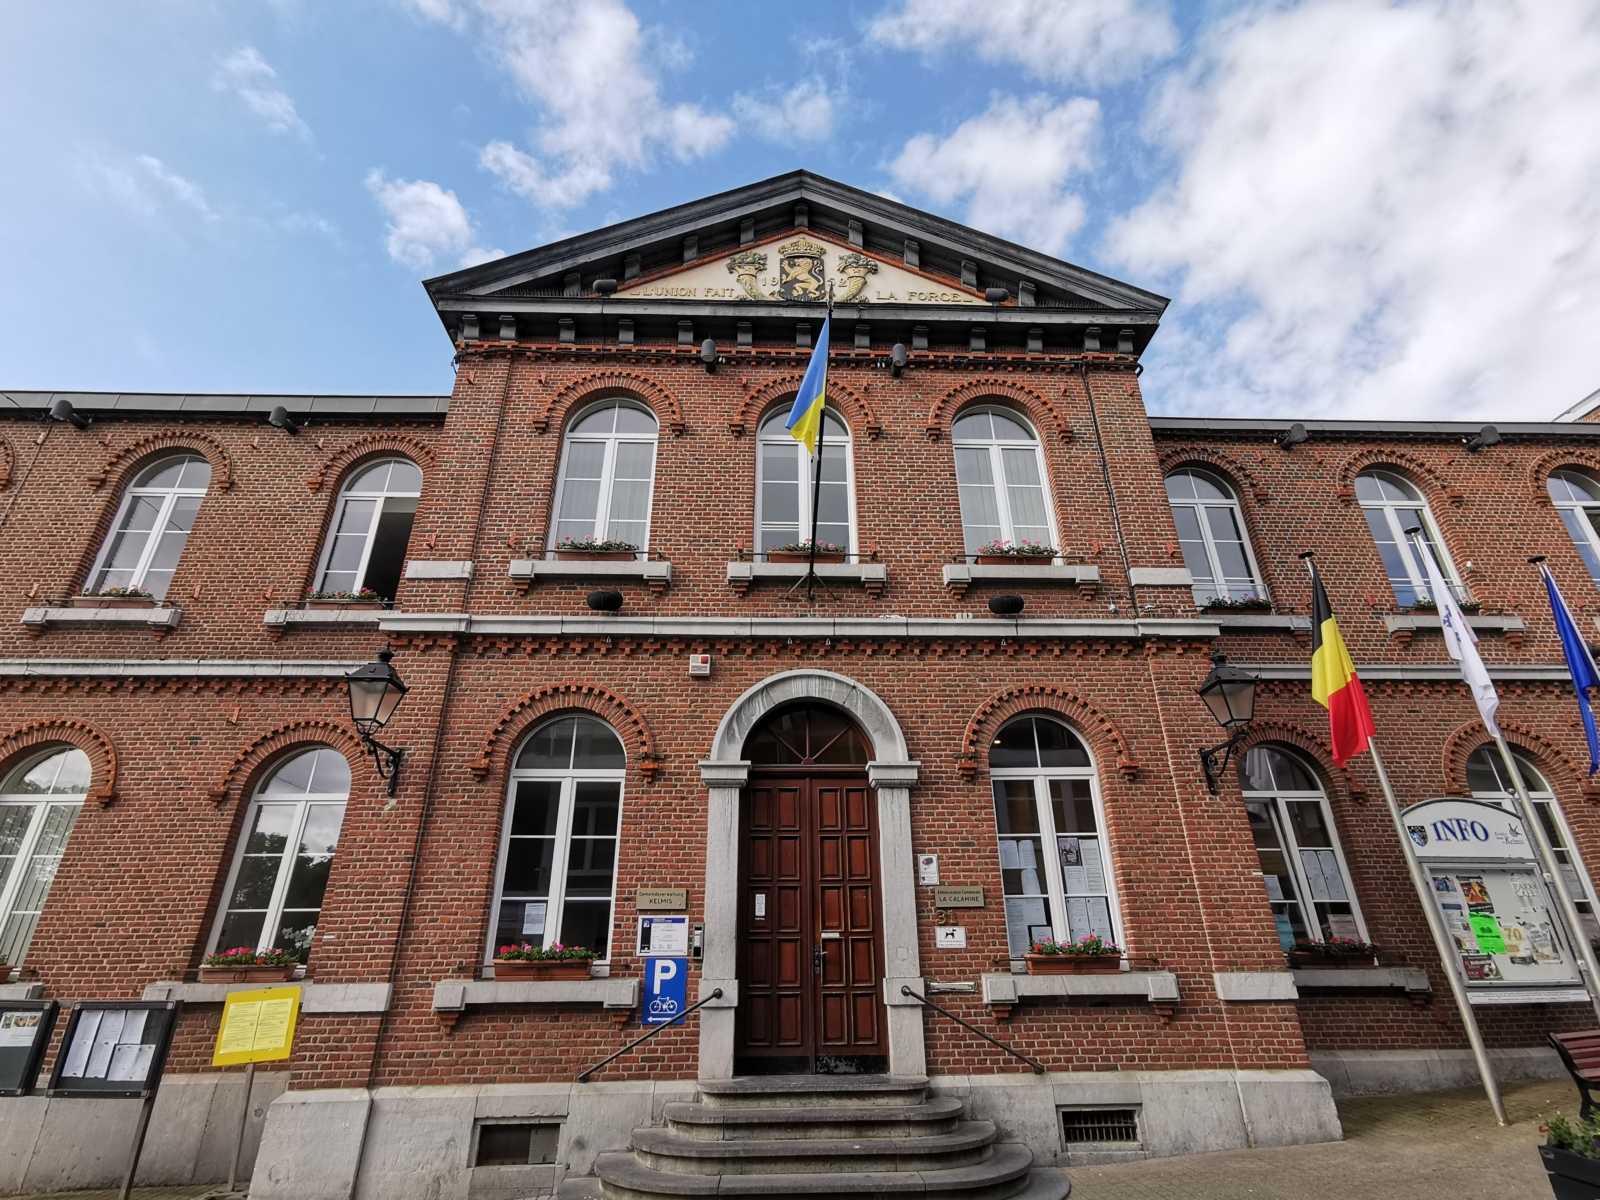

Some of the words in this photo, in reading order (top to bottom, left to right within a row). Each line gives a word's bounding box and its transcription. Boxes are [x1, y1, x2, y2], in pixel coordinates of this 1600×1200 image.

[642, 286, 697, 297] L'UNION
[703, 287, 735, 298] FAIT
[875, 290, 898, 301] LA
[907, 291, 962, 302] FORCE
[1430, 818, 1489, 842] INFO
[935, 909, 957, 925] 31
[1503, 927, 1522, 941] 70
[653, 959, 677, 995] P
